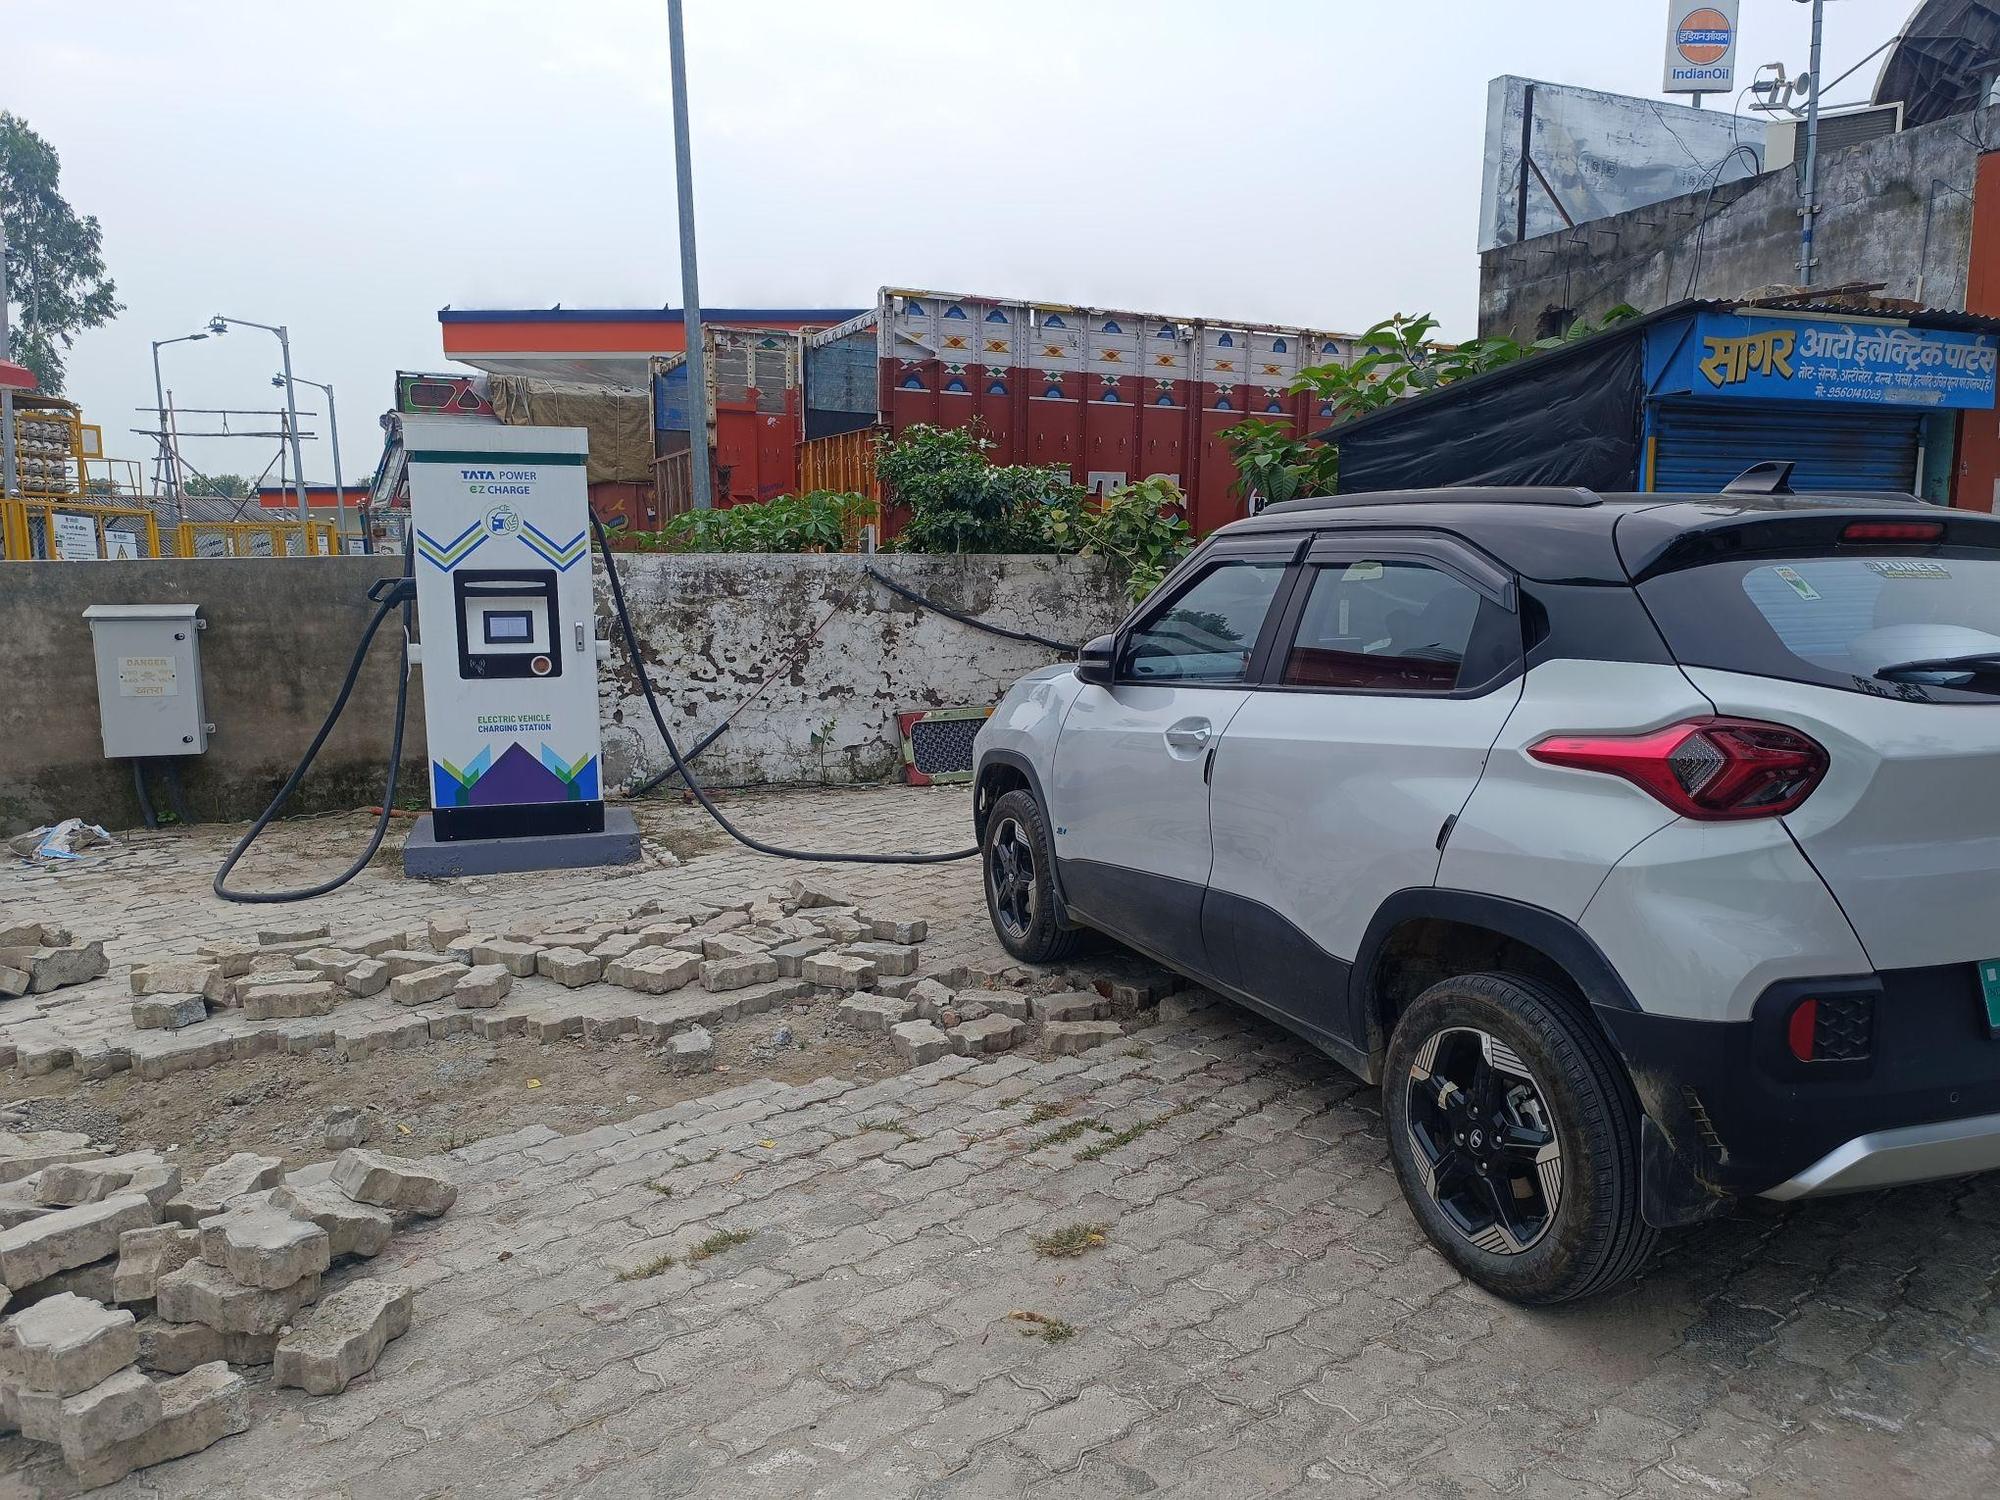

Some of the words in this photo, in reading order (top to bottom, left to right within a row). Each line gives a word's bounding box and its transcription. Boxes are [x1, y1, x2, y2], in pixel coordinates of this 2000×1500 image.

[1672, 68, 1729, 79] IndianOil
[1800, 325, 1857, 361] आटो
[1699, 330, 1796, 388] सागर
[461, 470, 495, 480] TATA
[500, 471, 537, 480] POWER
[487, 485, 530, 495] CHARGE
[477, 715, 516, 724] ELECTRIC
[518, 714, 551, 723] VEHICLE
[478, 724, 518, 733] CHARGING
[519, 723, 552, 732] STATION
